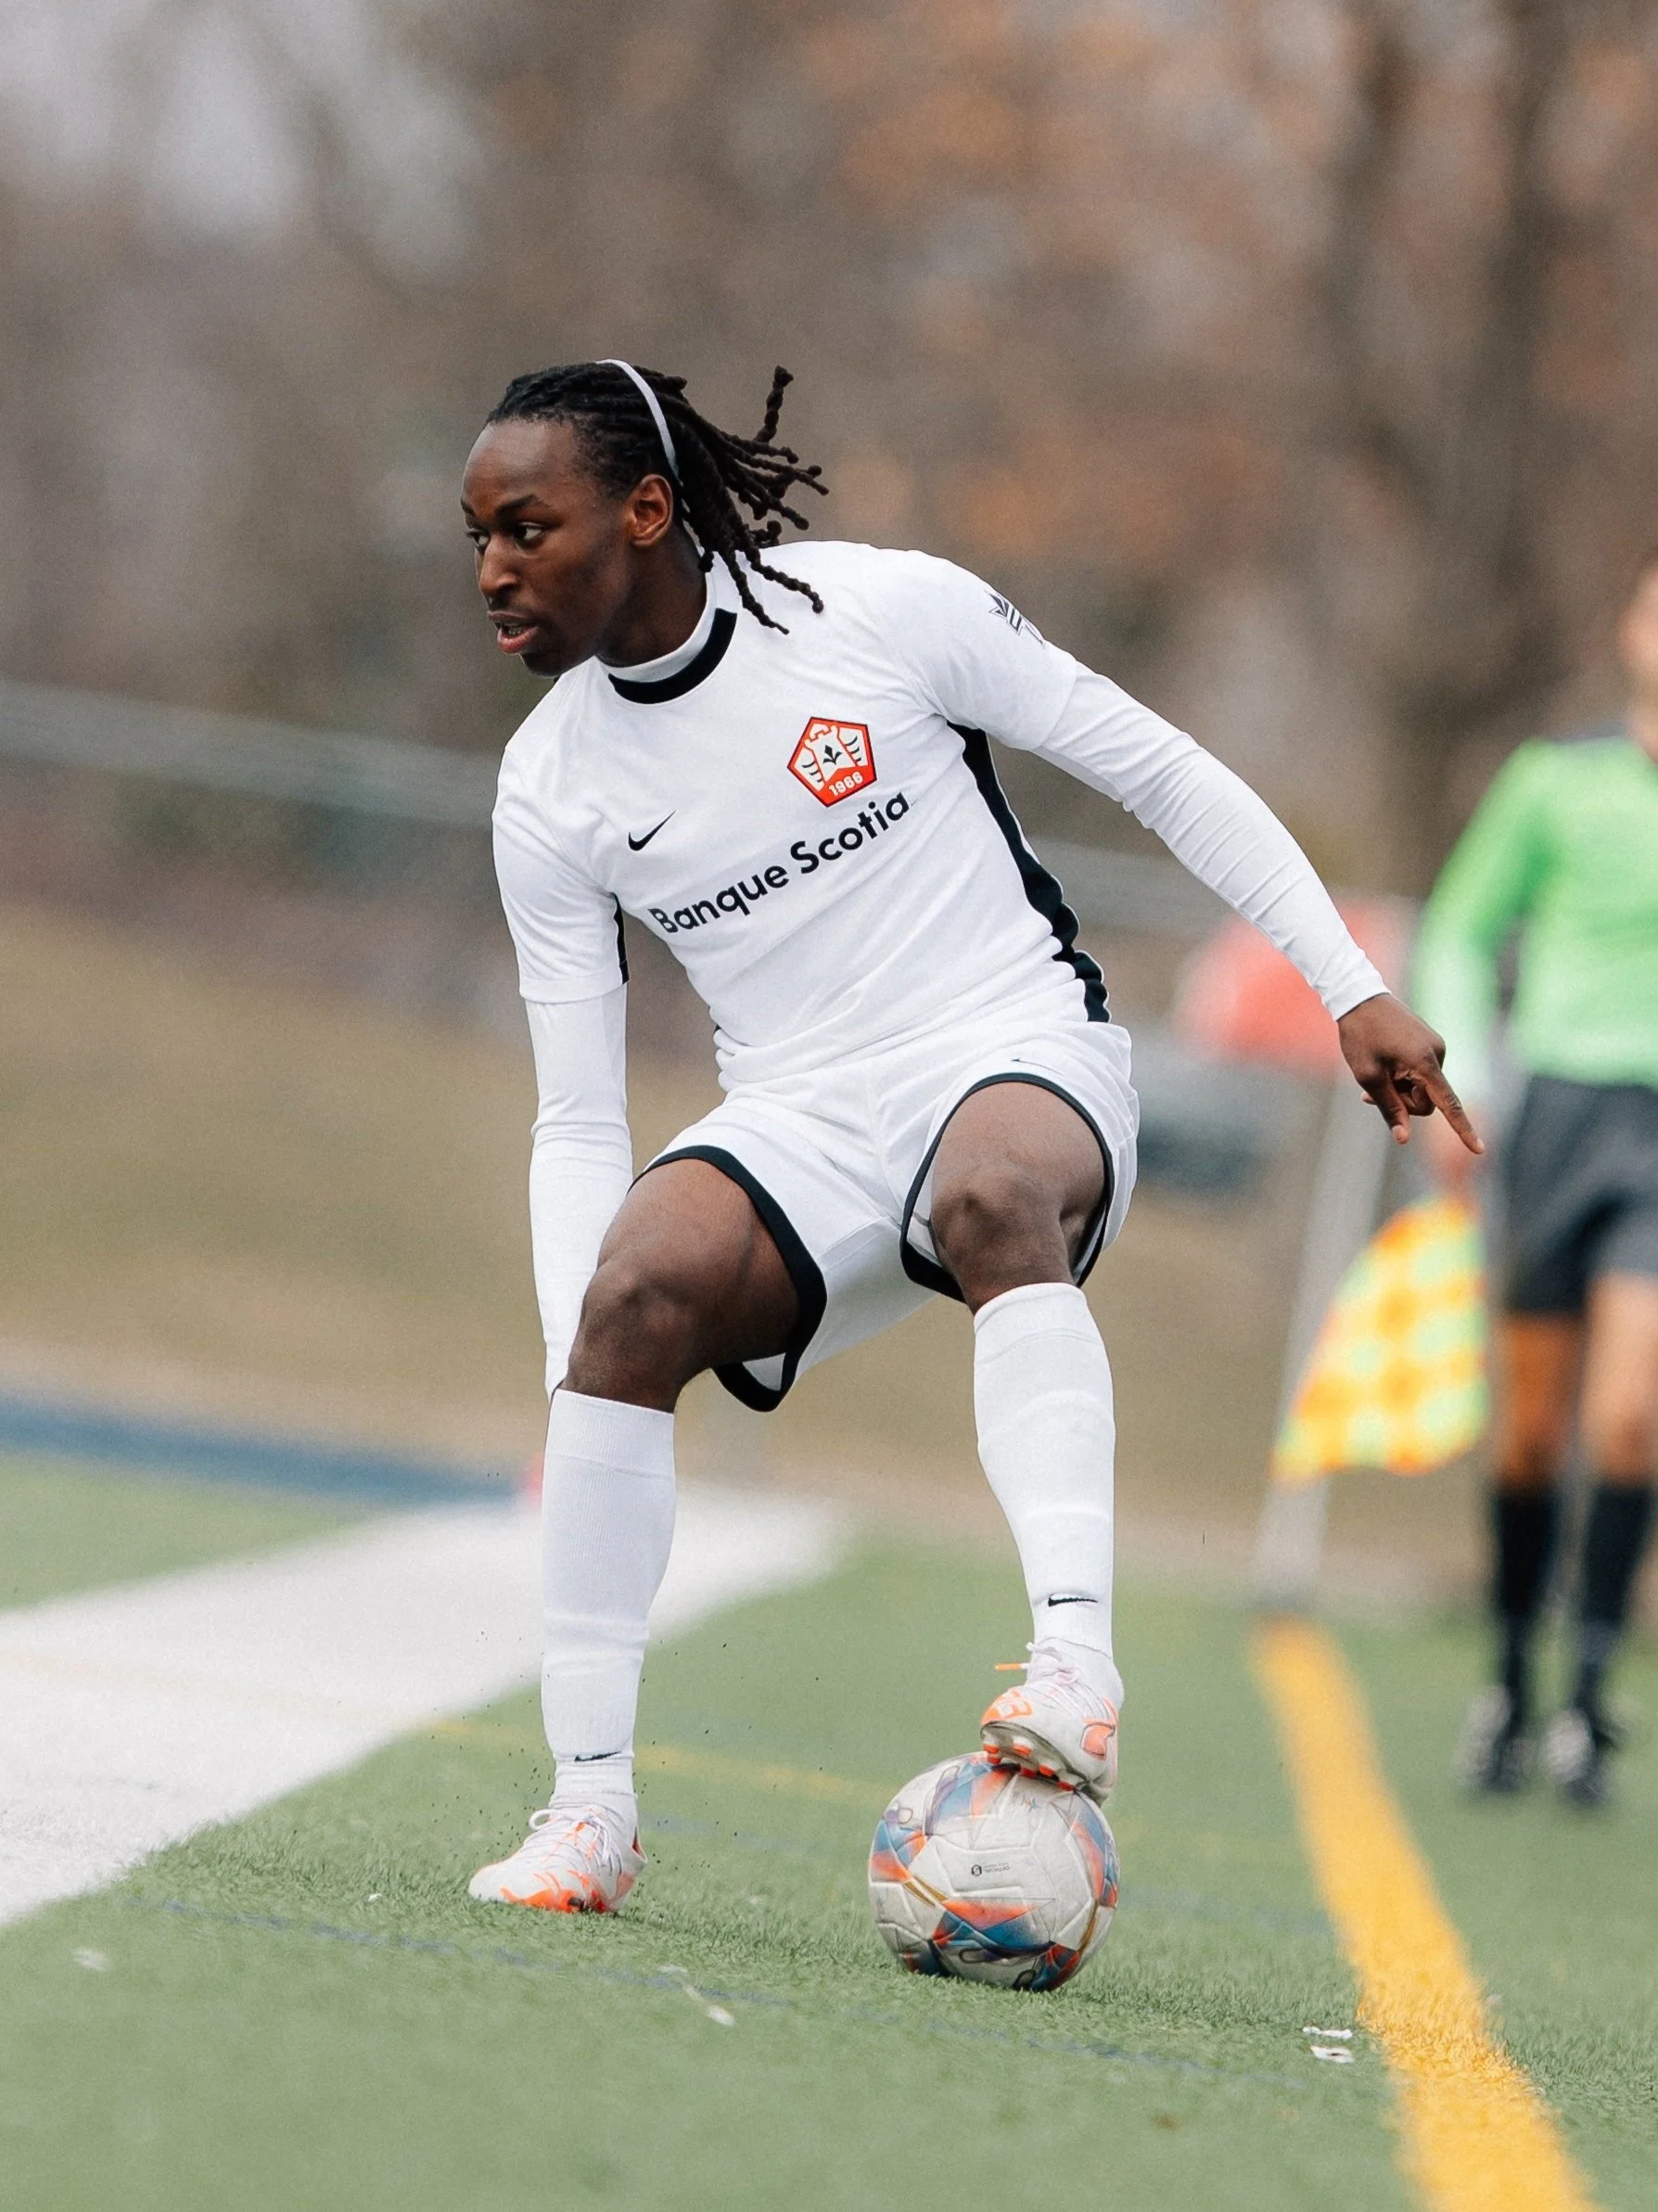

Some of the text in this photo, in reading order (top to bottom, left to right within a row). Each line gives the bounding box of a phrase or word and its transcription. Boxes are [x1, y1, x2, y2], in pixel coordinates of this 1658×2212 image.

[829, 772, 863, 796] 1966
[648, 792, 910, 933] Banque Scotia
